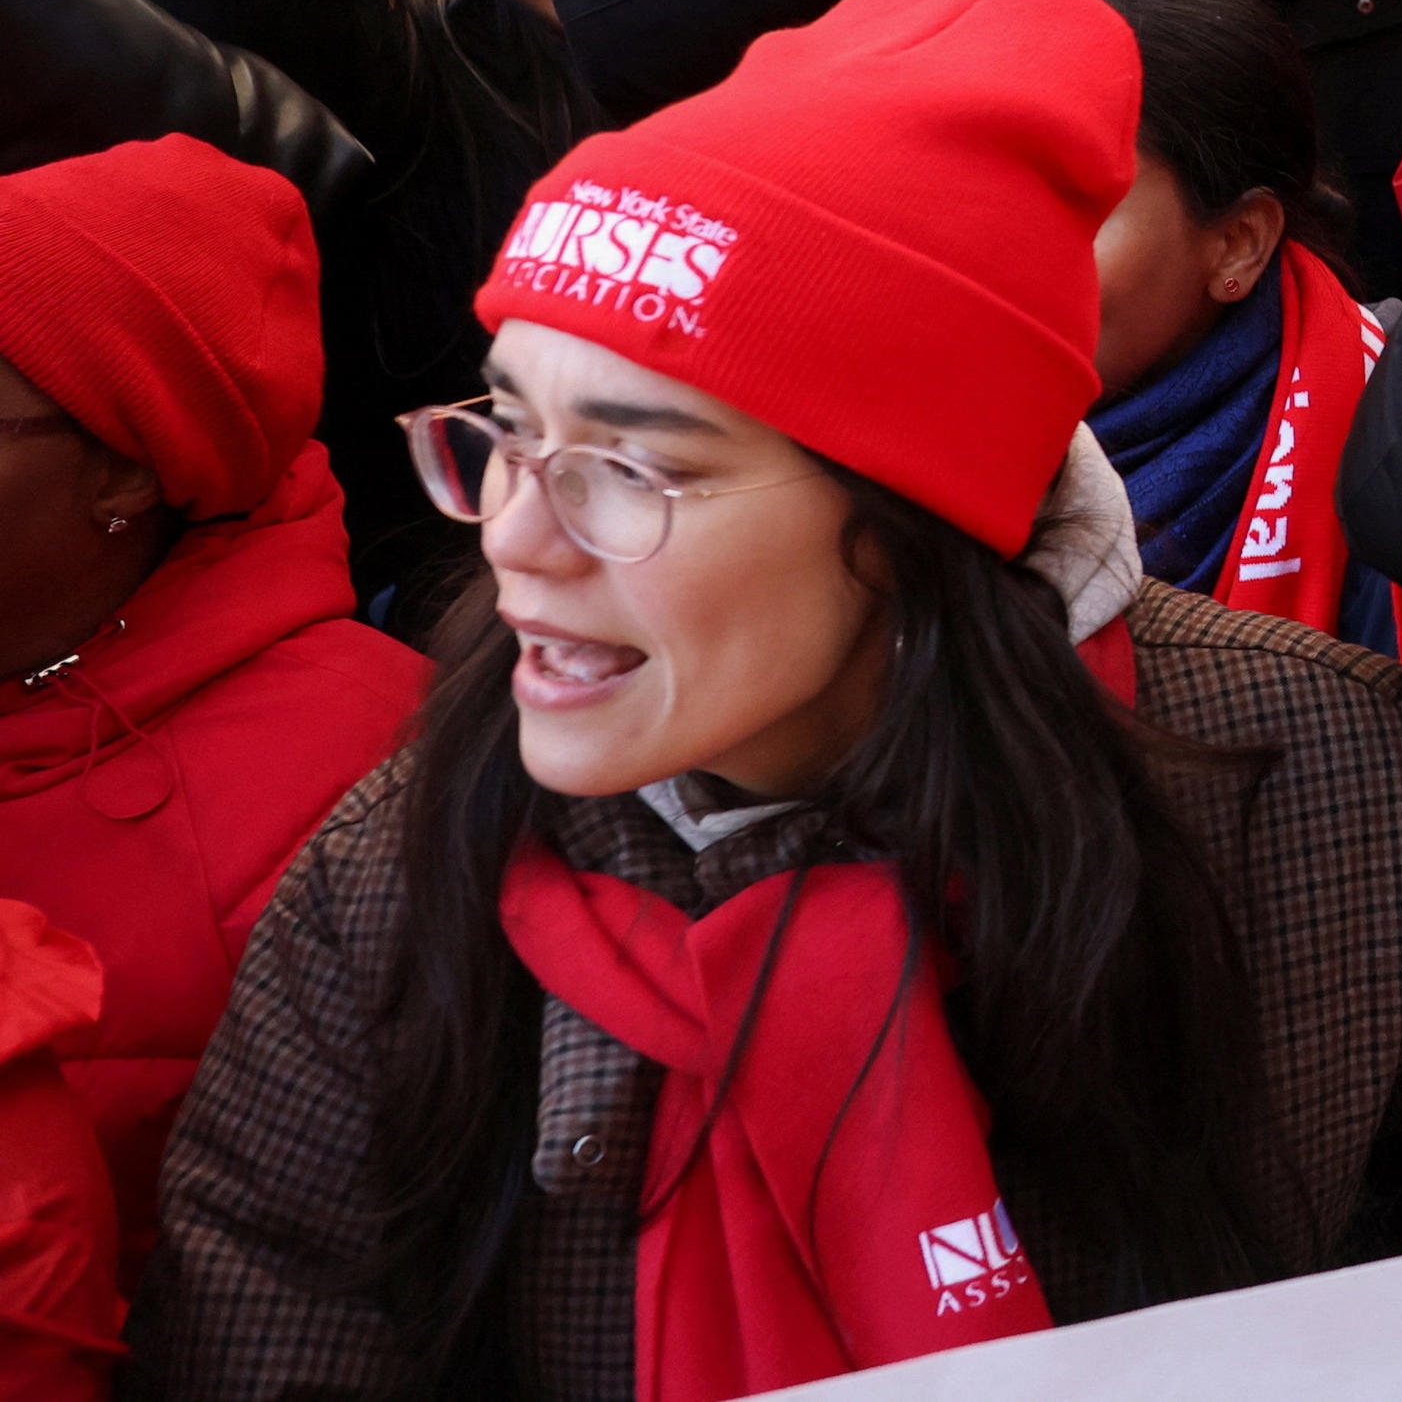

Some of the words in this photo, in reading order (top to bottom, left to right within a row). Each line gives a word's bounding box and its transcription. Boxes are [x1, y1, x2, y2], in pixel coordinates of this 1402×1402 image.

[564, 178, 615, 208] New
[616, 186, 673, 224] York
[670, 203, 739, 247] State
